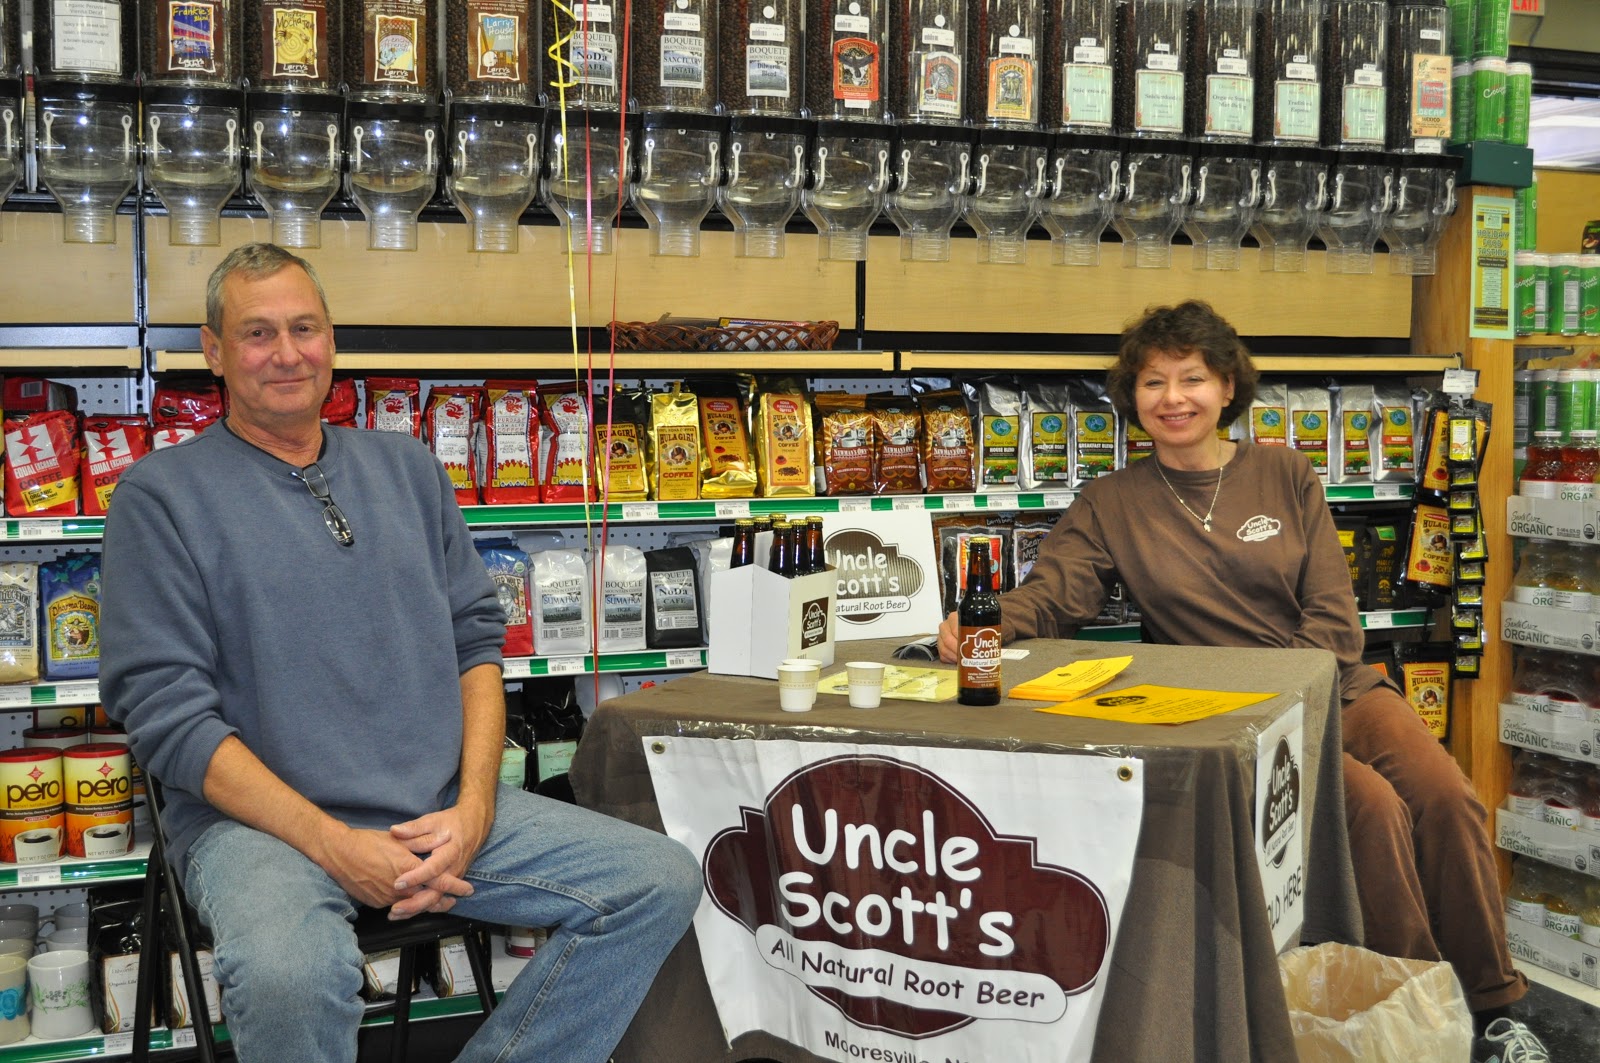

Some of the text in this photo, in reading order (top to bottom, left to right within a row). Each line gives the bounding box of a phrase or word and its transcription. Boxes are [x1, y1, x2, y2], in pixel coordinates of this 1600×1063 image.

[486, 18, 515, 29] Larry's
[488, 26, 515, 36] House
[664, 37, 702, 46] BOQUETE
[577, 51, 607, 61] NoDa
[749, 46, 786, 55] BOQUETE
[1477, 229, 1509, 240] HOLIDAY
[618, 429, 635, 438] GIRL
[660, 433, 695, 444] HULA GIRL
[13, 457, 59, 479] EQUAL EXCHANGE
[90, 455, 134, 476] EQUAL EXCHANGE
[20, 471, 63, 490] COFFEE
[1247, 518, 1268, 529] Uncle
[1423, 519, 1442, 529] HULA
[1511, 522, 1554, 536] ORGANIC
[825, 547, 887, 572] Uncle
[1423, 552, 1449, 563] COFFEE
[653, 571, 691, 579] BOQUETE
[605, 581, 642, 589] BOQUETE
[836, 570, 900, 596] cott's
[659, 587, 688, 595] NoDa
[543, 596, 580, 604] SUMATRA
[606, 596, 641, 604] SUMATRA
[836, 598, 906, 613] atural Root Beer
[52, 599, 97, 616] Dharma Beans
[808, 609, 820, 620] Uncle
[806, 619, 822, 630] Scott's
[974, 636, 998, 648] Uncle
[1504, 628, 1549, 645] ORGANIC
[971, 647, 1000, 659] Scott's
[1411, 676, 1444, 686] HULA GIRL
[1503, 729, 1549, 748] ORGANIC
[1271, 754, 1291, 797] Uncle
[7, 780, 59, 809] pero
[77, 776, 129, 804] pero
[1269, 787, 1293, 832] Scott's
[791, 803, 981, 882] Uncle
[1500, 836, 1544, 858] ORGANIC
[1283, 864, 1302, 910] HERE
[778, 871, 1015, 956] Scott's
[771, 937, 1046, 1010] All Natural Root Beer
